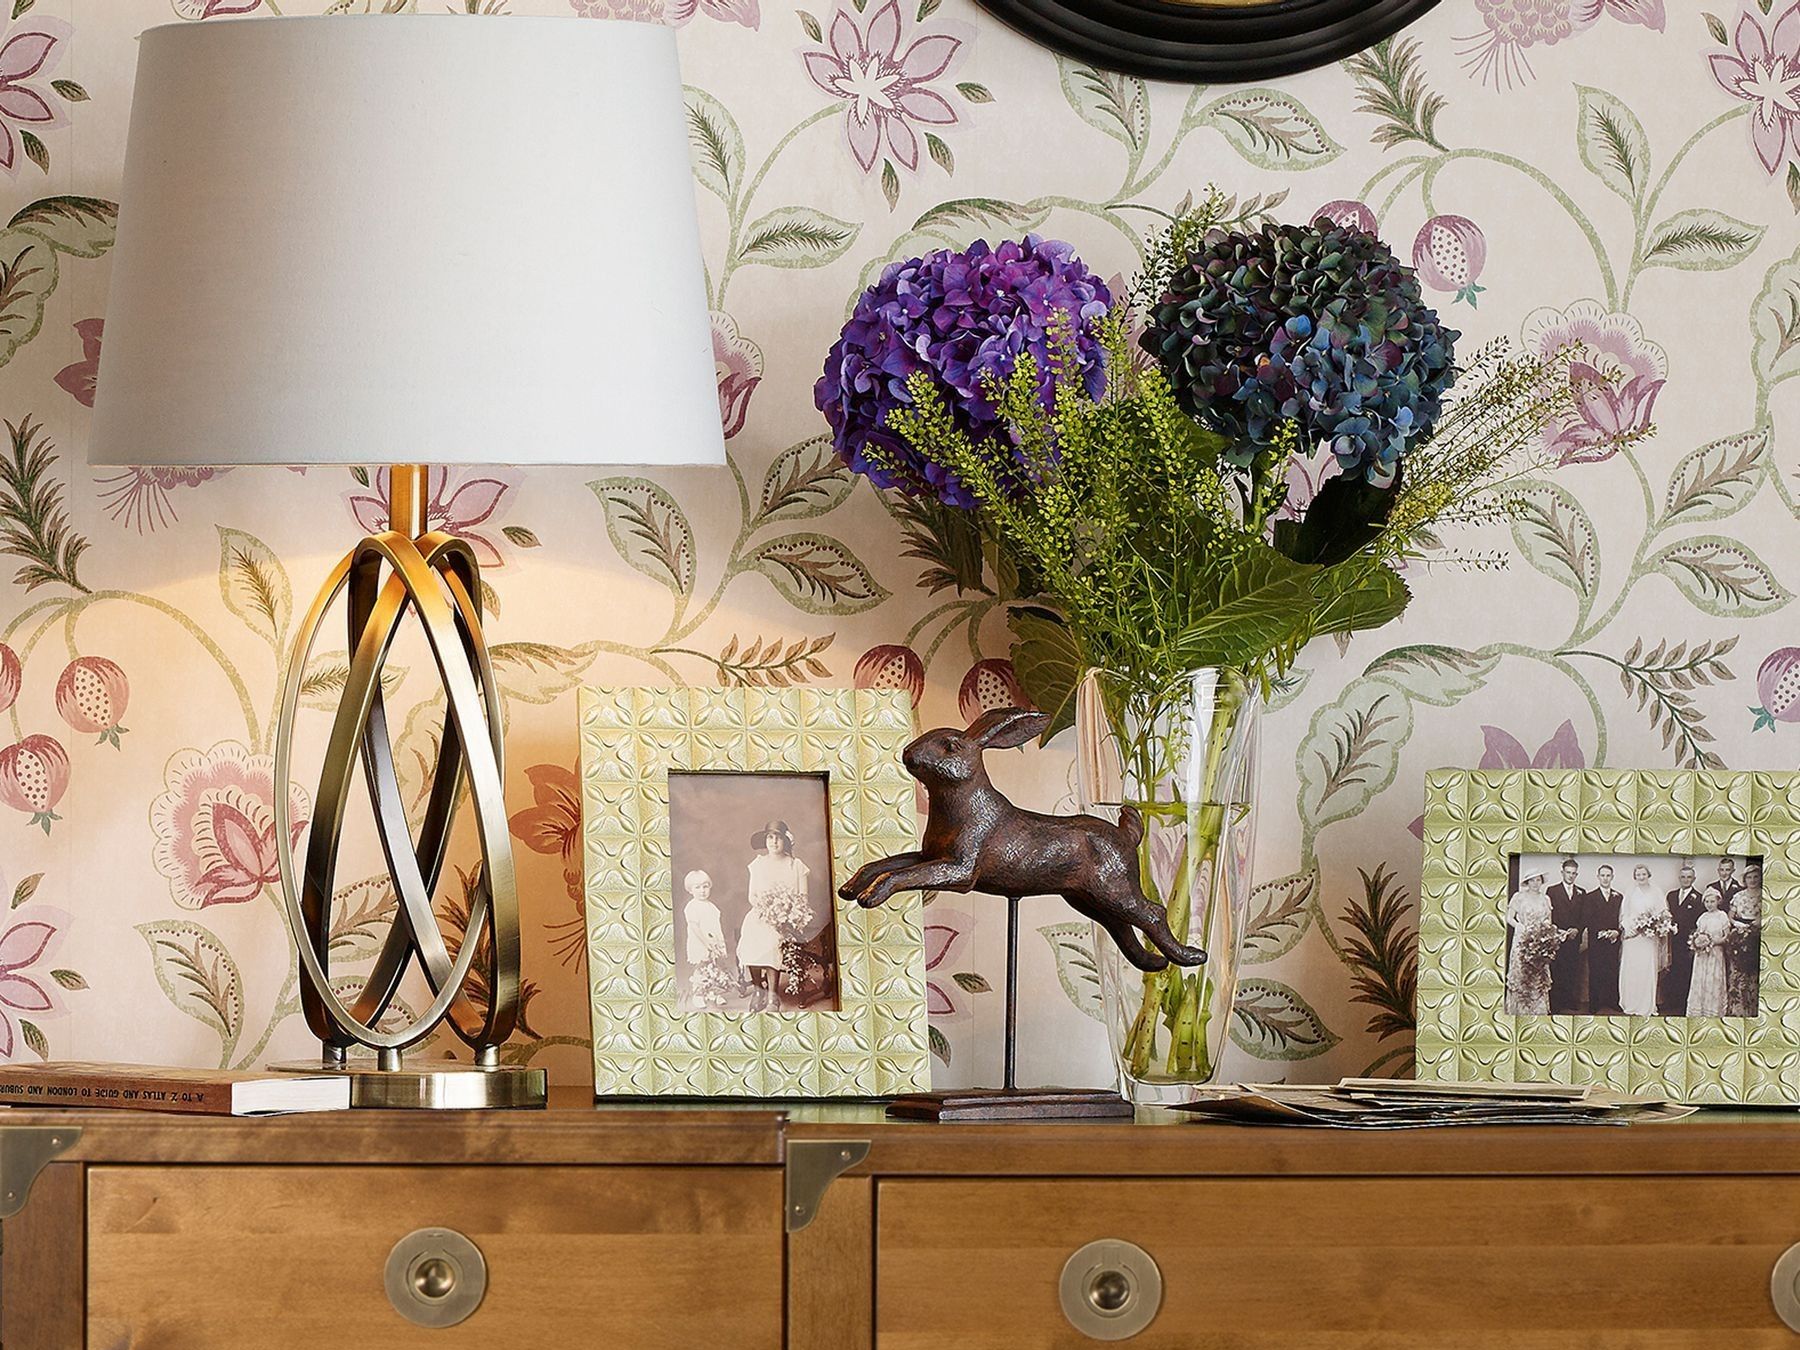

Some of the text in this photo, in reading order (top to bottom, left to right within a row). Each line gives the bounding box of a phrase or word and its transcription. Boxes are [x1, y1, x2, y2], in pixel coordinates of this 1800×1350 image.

[0, 1084, 23, 1094] SUBUR
[28, 1085, 43, 1095] AND
[47, 1086, 77, 1096] LONDON
[81, 1088, 91, 1097] TO
[95, 1089, 119, 1098] GUIDE
[123, 1090, 139, 1099] AND
[143, 1091, 166, 1100] ATLAS
[182, 1092, 192, 1101] TO
